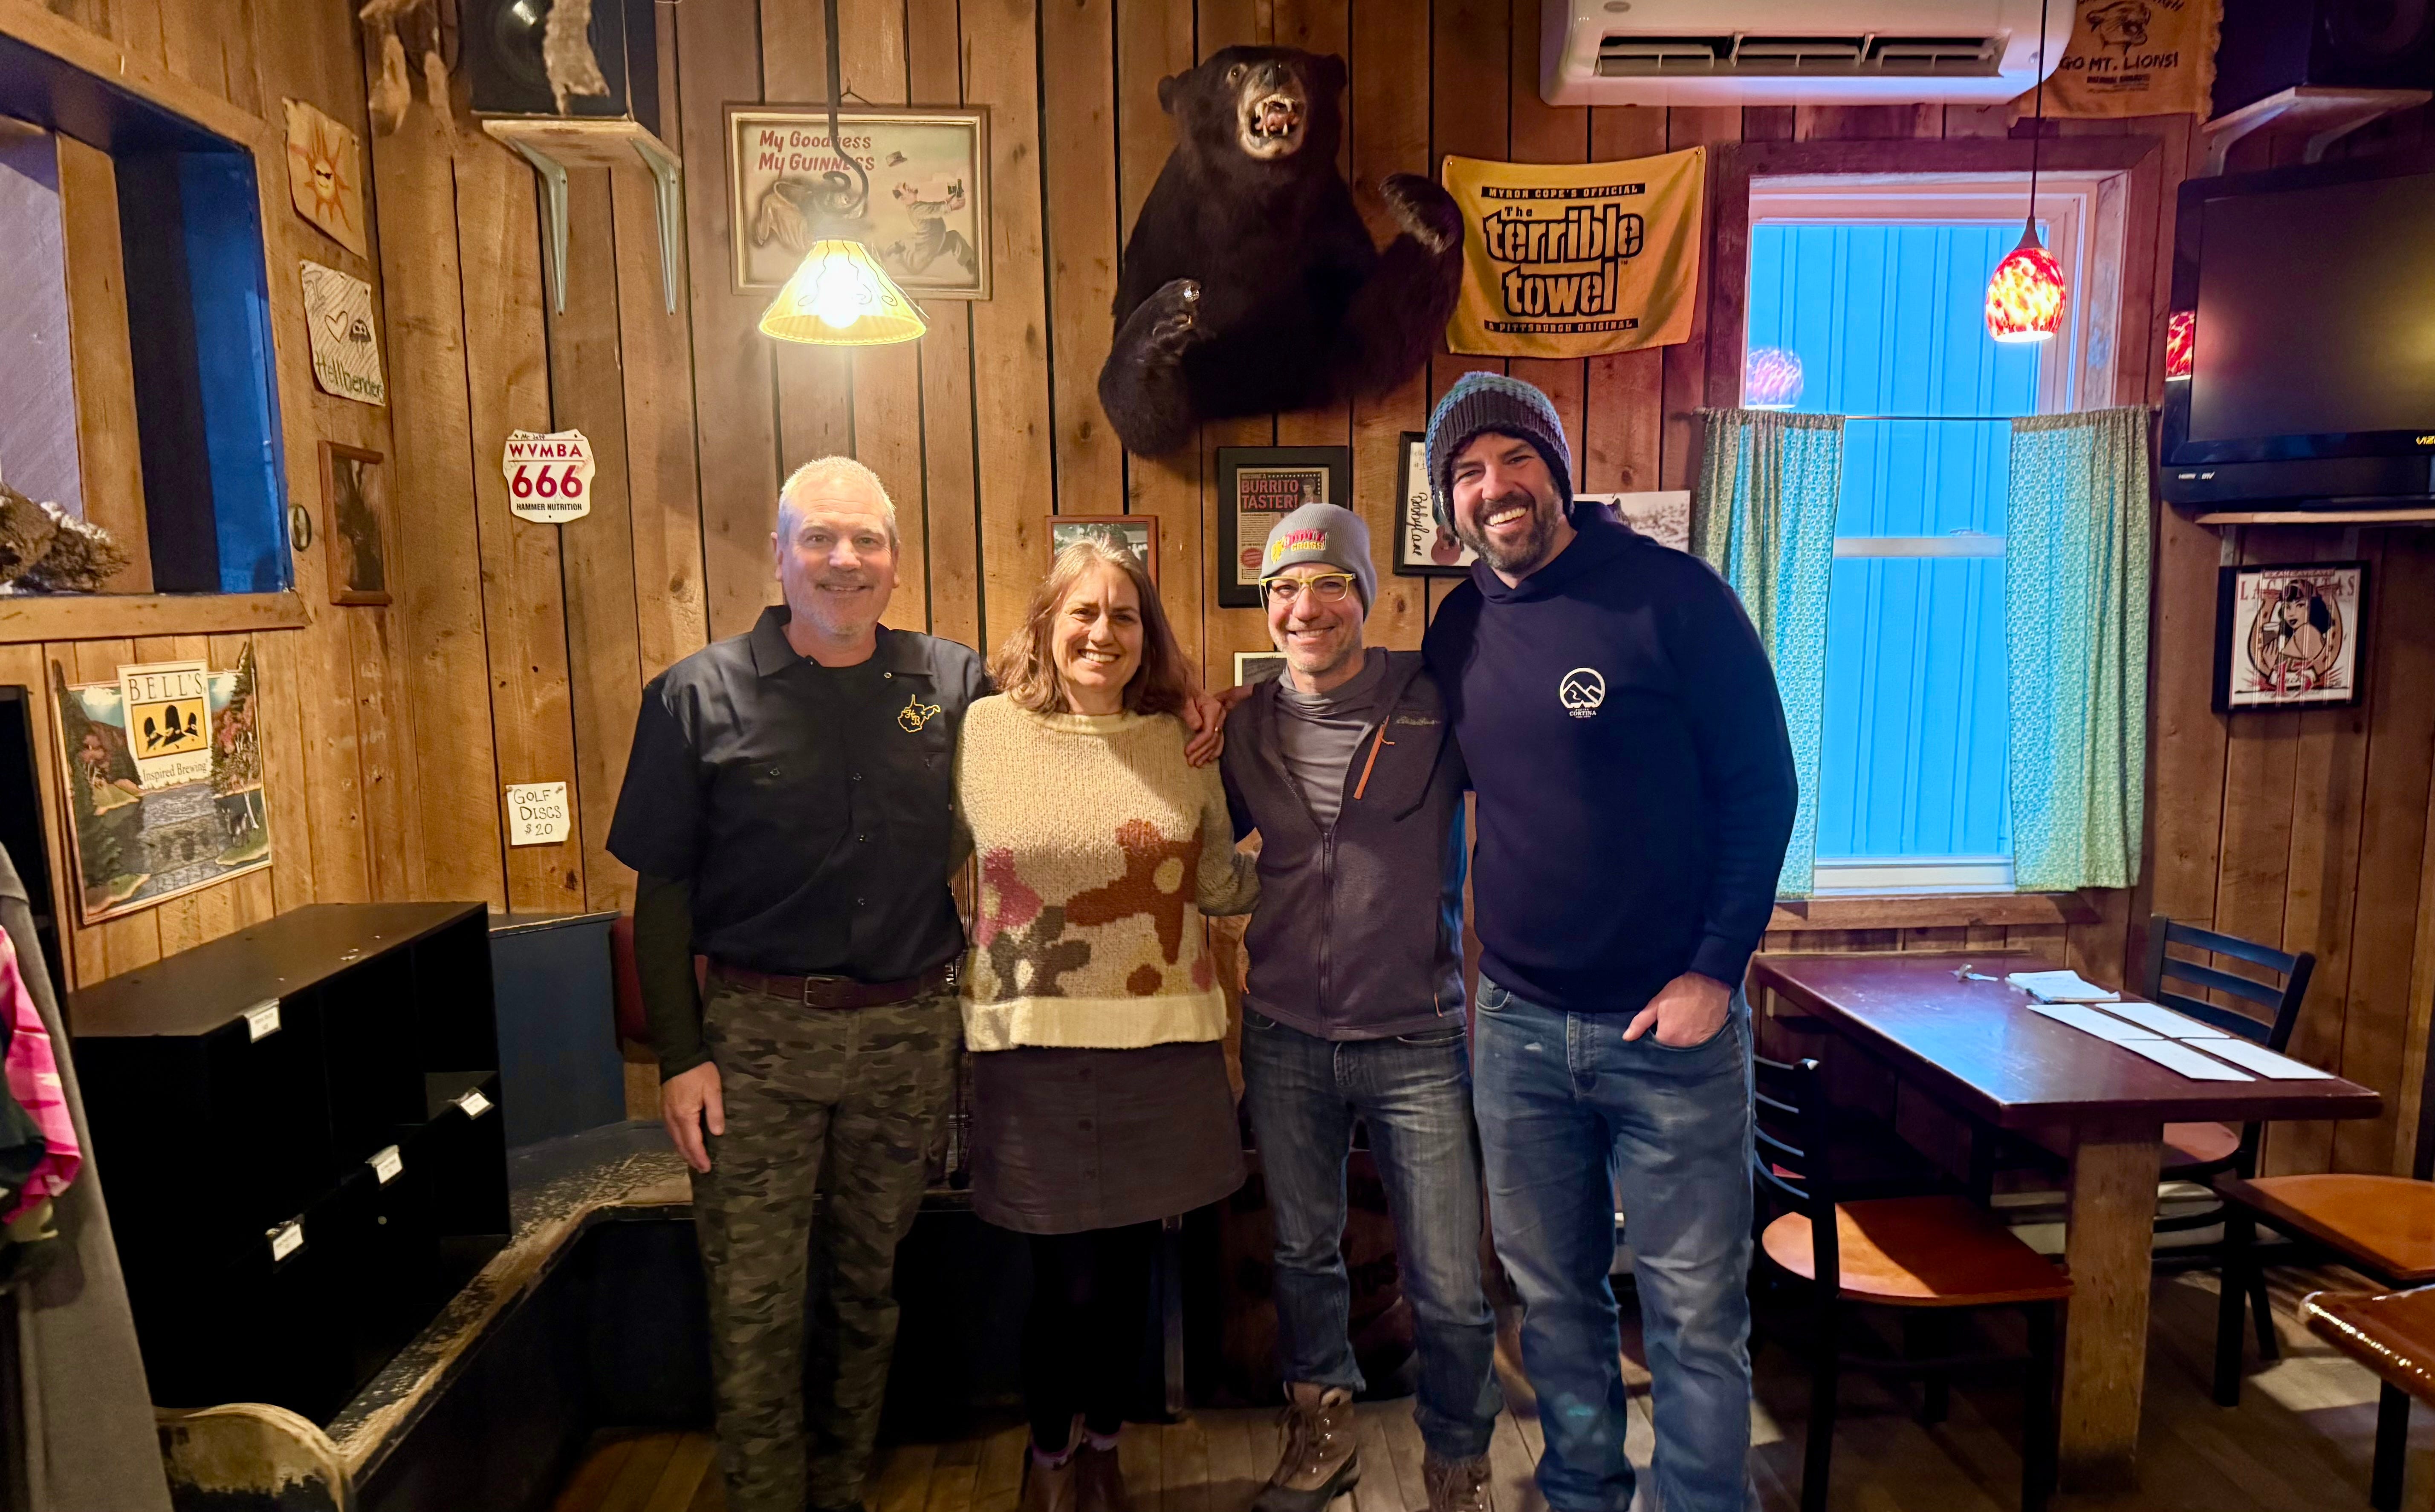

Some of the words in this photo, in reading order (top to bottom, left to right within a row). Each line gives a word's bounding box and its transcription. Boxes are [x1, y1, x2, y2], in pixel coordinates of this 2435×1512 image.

[760, 130, 784, 152] My
[758, 153, 785, 178] My
[1489, 188, 1529, 199] MYRON
[1536, 189, 1576, 199] COPE'S
[1583, 185, 1637, 196] OFFICIAL
[1505, 206, 1533, 217] The
[1483, 203, 1643, 263] terrible
[1502, 258, 1619, 317] towel
[1500, 323, 1571, 333] PITTSBURGH
[1577, 319, 1632, 332] ORIGINAL
[509, 443, 583, 458] WVMBA
[512, 465, 583, 498] 666
[1241, 479, 1299, 493] BURRITO
[1241, 494, 1298, 509] TASTER!
[128, 672, 203, 701] BELL'S
[142, 764, 175, 782] Inspired
[176, 762, 206, 775] Brewing
[514, 789, 551, 804] GOLF
[520, 805, 562, 821] DISCS
